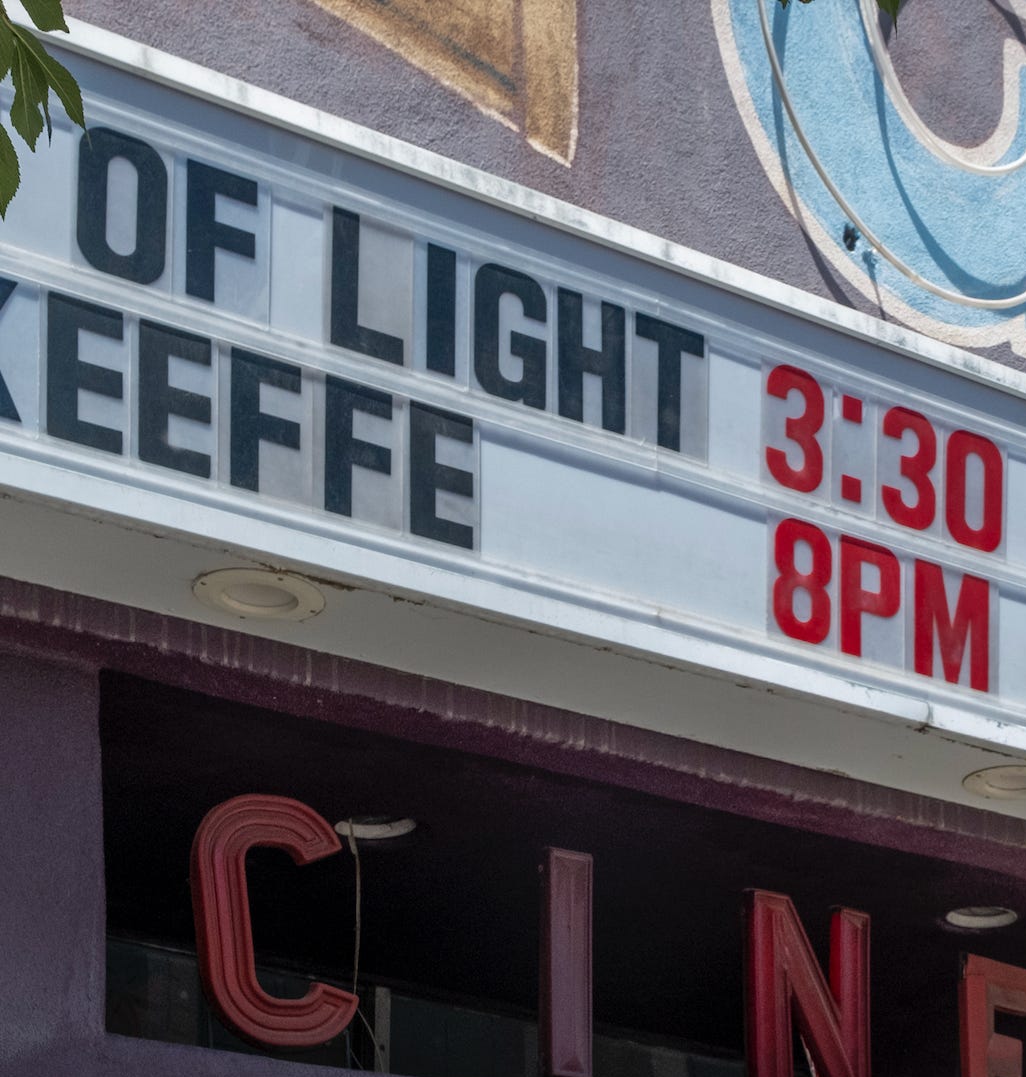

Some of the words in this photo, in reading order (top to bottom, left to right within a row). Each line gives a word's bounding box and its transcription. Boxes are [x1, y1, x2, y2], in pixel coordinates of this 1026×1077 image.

[76, 126, 258, 303] OF
[330, 205, 705, 453] LIGHT
[765, 364, 1001, 553] 3:30
[772, 517, 991, 691] 8PM
